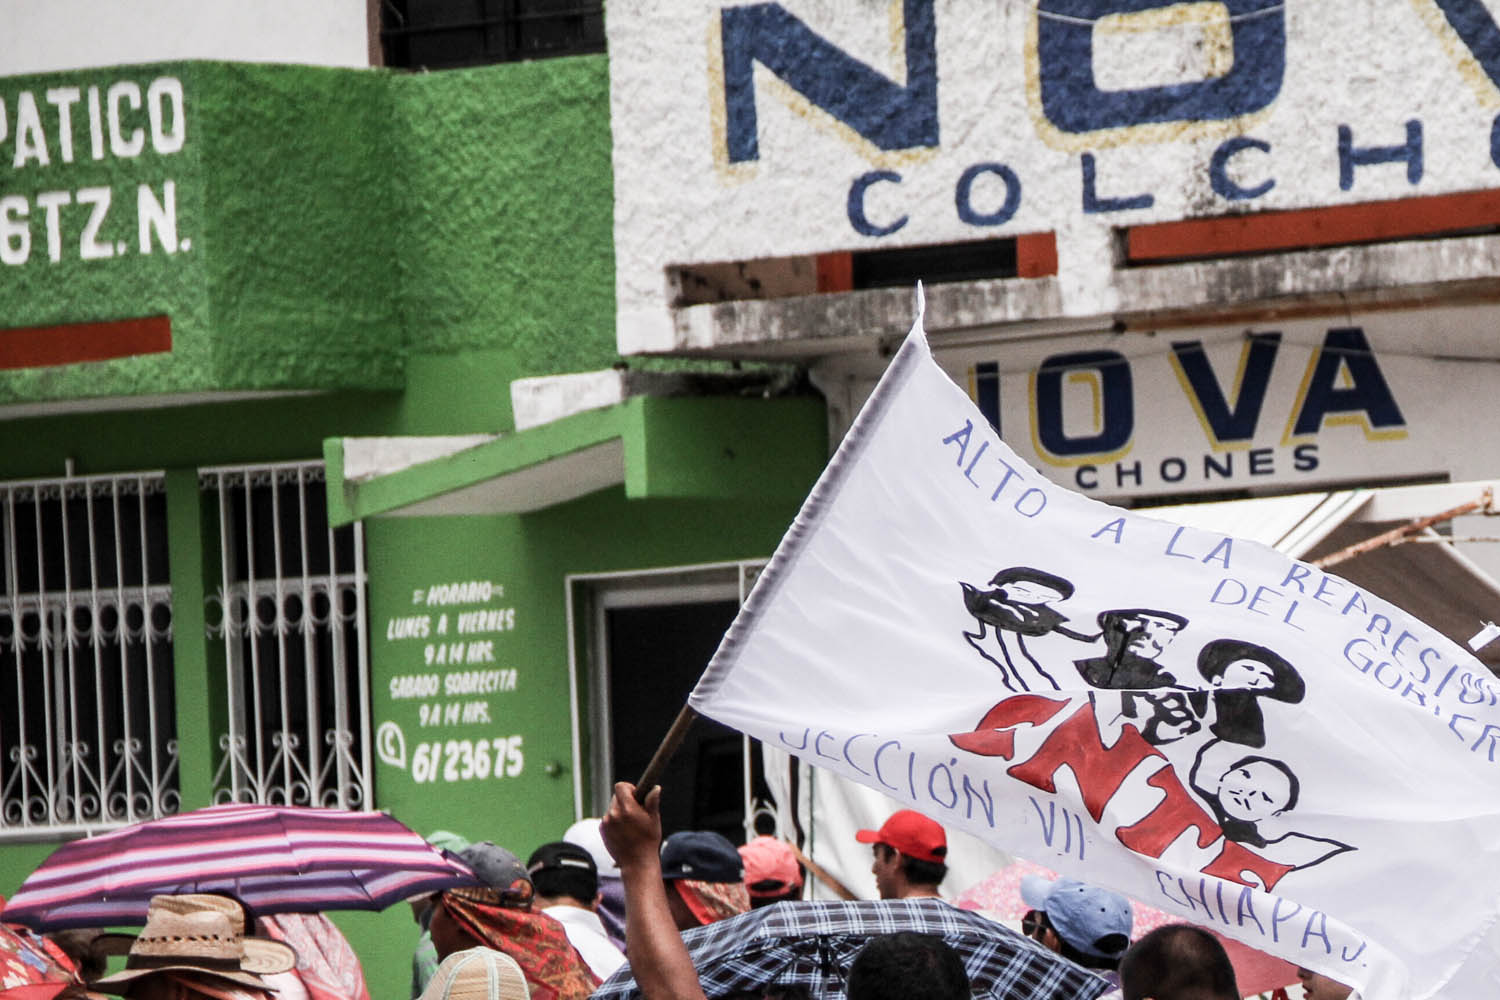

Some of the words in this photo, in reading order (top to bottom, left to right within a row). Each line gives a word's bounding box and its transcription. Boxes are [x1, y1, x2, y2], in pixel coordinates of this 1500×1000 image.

[138, 178, 192, 255] N.
[1073, 443, 1321, 490] CHONES
[942, 418, 1048, 519] ALTO
[1090, 517, 1127, 545] A
[1164, 525, 1234, 570] LA
[426, 581, 493, 606] HORARIO
[1209, 578, 1305, 632] DEL
[387, 616, 431, 640] LUNES
[436, 613, 448, 635] A
[457, 608, 516, 635] VIERNES
[424, 644, 435, 666] 9
[436, 643, 446, 665] A
[389, 673, 440, 700] SABADO
[419, 703, 430, 727] 9
[429, 703, 441, 726] A
[1028, 795, 1085, 861] VII
